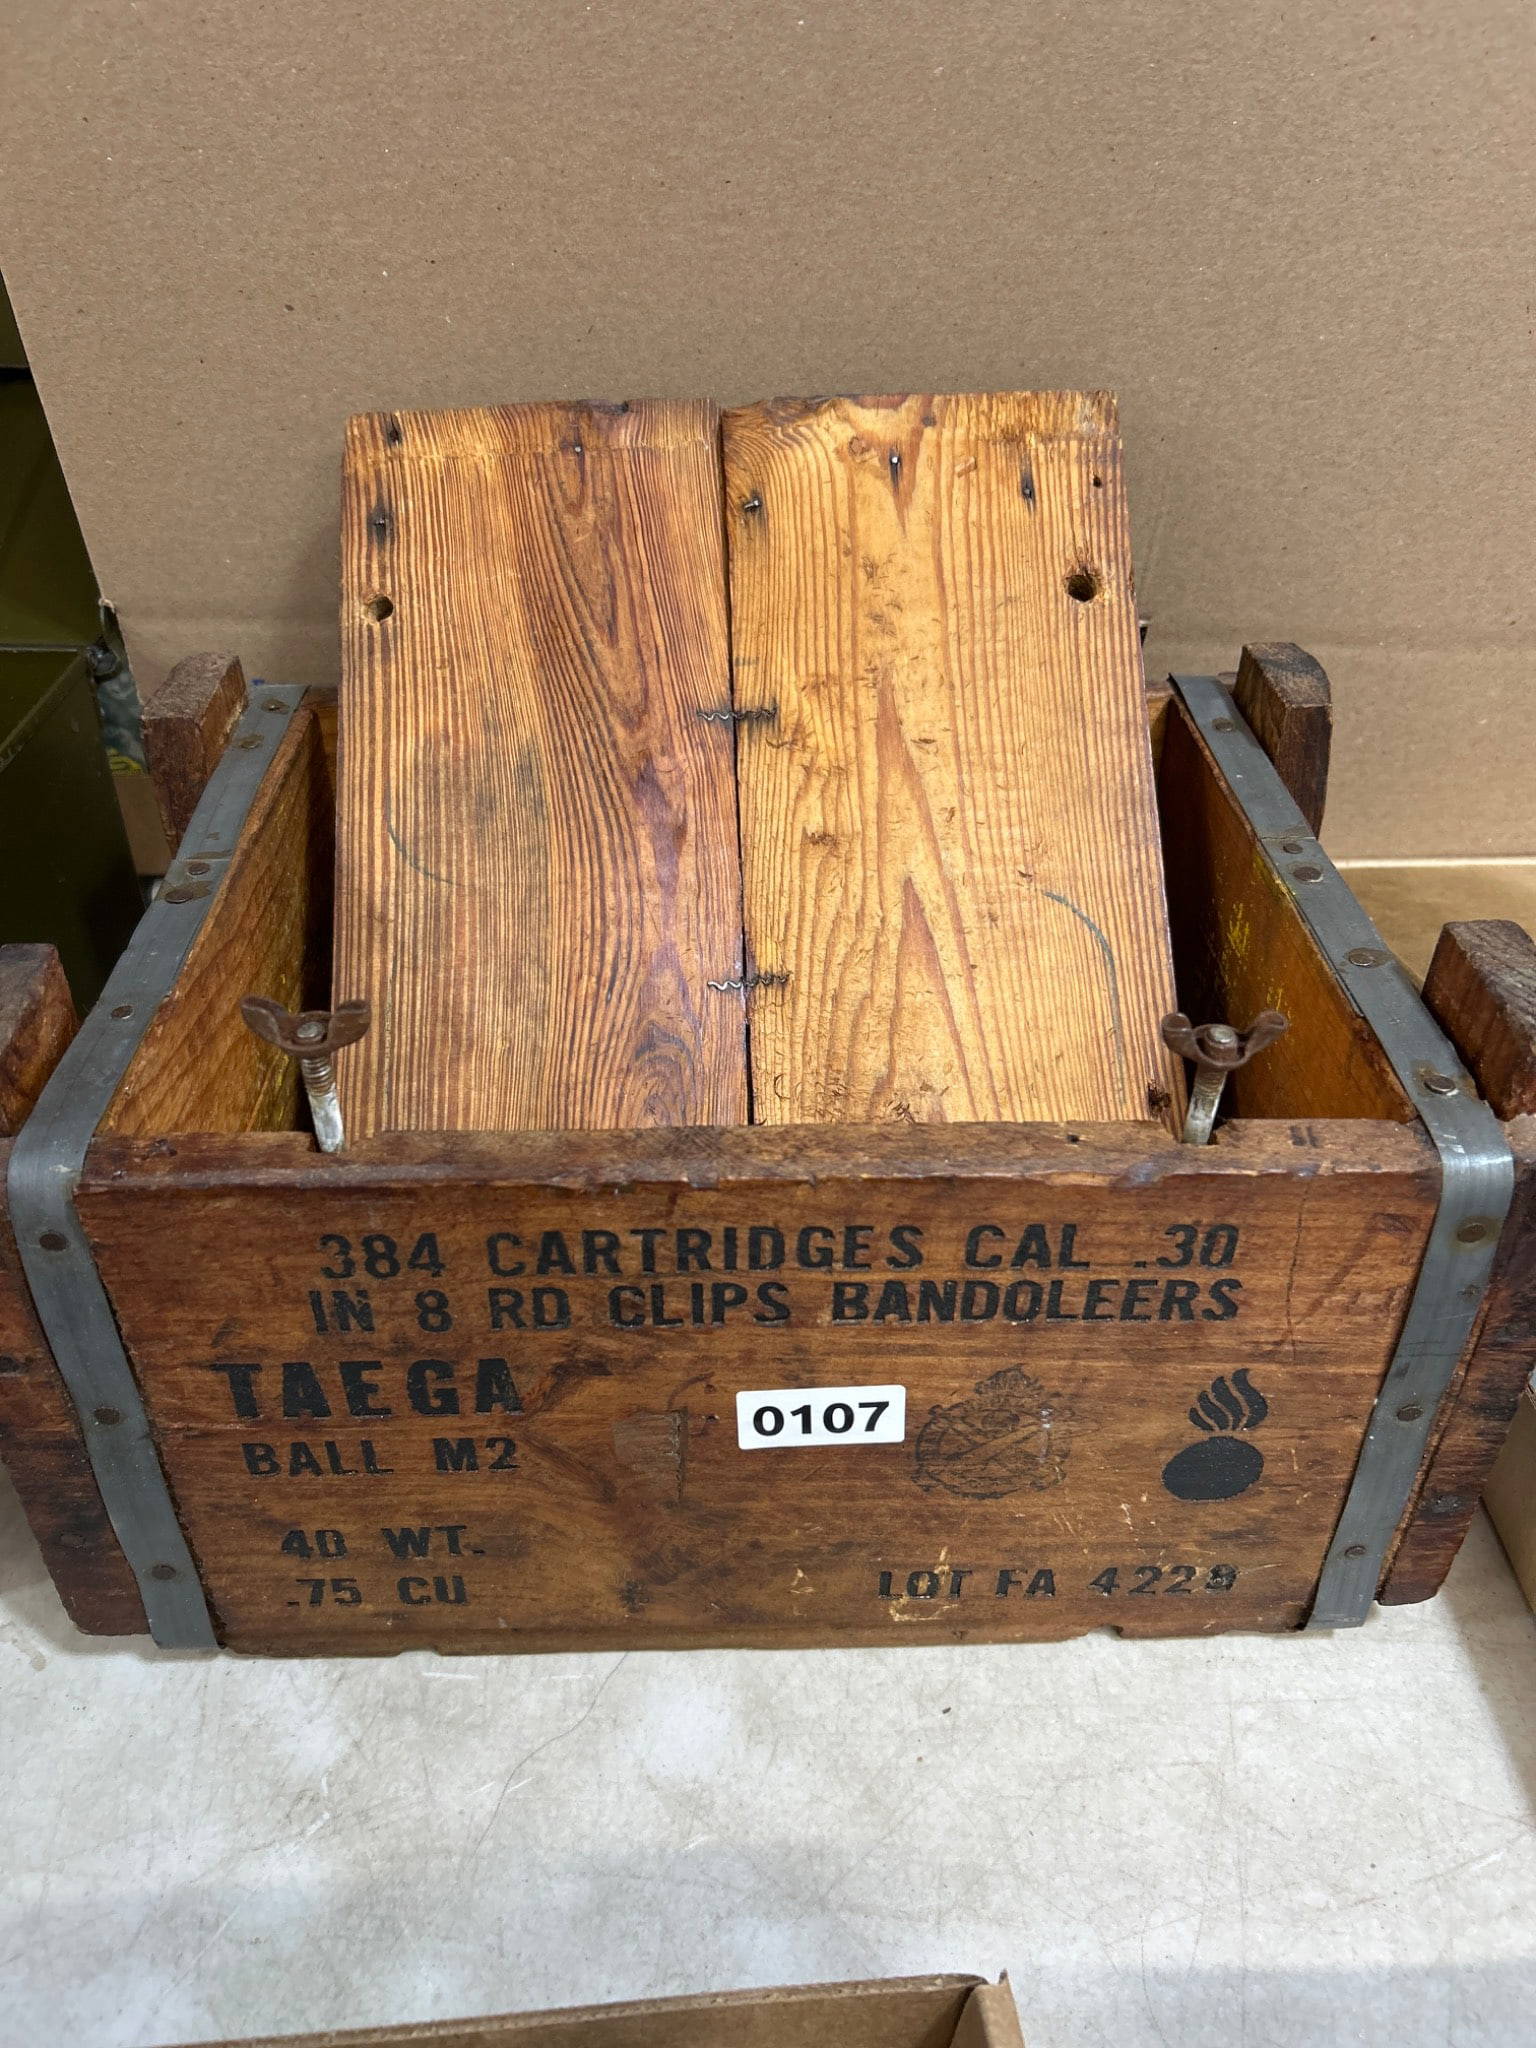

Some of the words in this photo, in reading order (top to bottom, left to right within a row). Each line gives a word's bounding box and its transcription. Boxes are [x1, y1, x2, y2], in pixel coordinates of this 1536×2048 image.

[320, 1233, 446, 1279] 384
[486, 1225, 924, 1277] CARTRIDGES
[963, 1225, 1090, 1270] CAL
[1134, 1224, 1240, 1269] .30
[309, 1290, 374, 1333] IN
[415, 1290, 453, 1332] 8
[488, 1286, 572, 1330] RD
[609, 1281, 790, 1328] CLIPS
[832, 1278, 1244, 1324] BANDOLEERS
[211, 1358, 525, 1419] TAEGA
[752, 1401, 890, 1437] 0107
[242, 1440, 394, 1477] BALL
[432, 1437, 519, 1472] M2
[381, 1526, 486, 1557] WT.
[397, 1575, 467, 1606] CU
[879, 1569, 973, 1598] LOT
[995, 1568, 1056, 1597] FA
